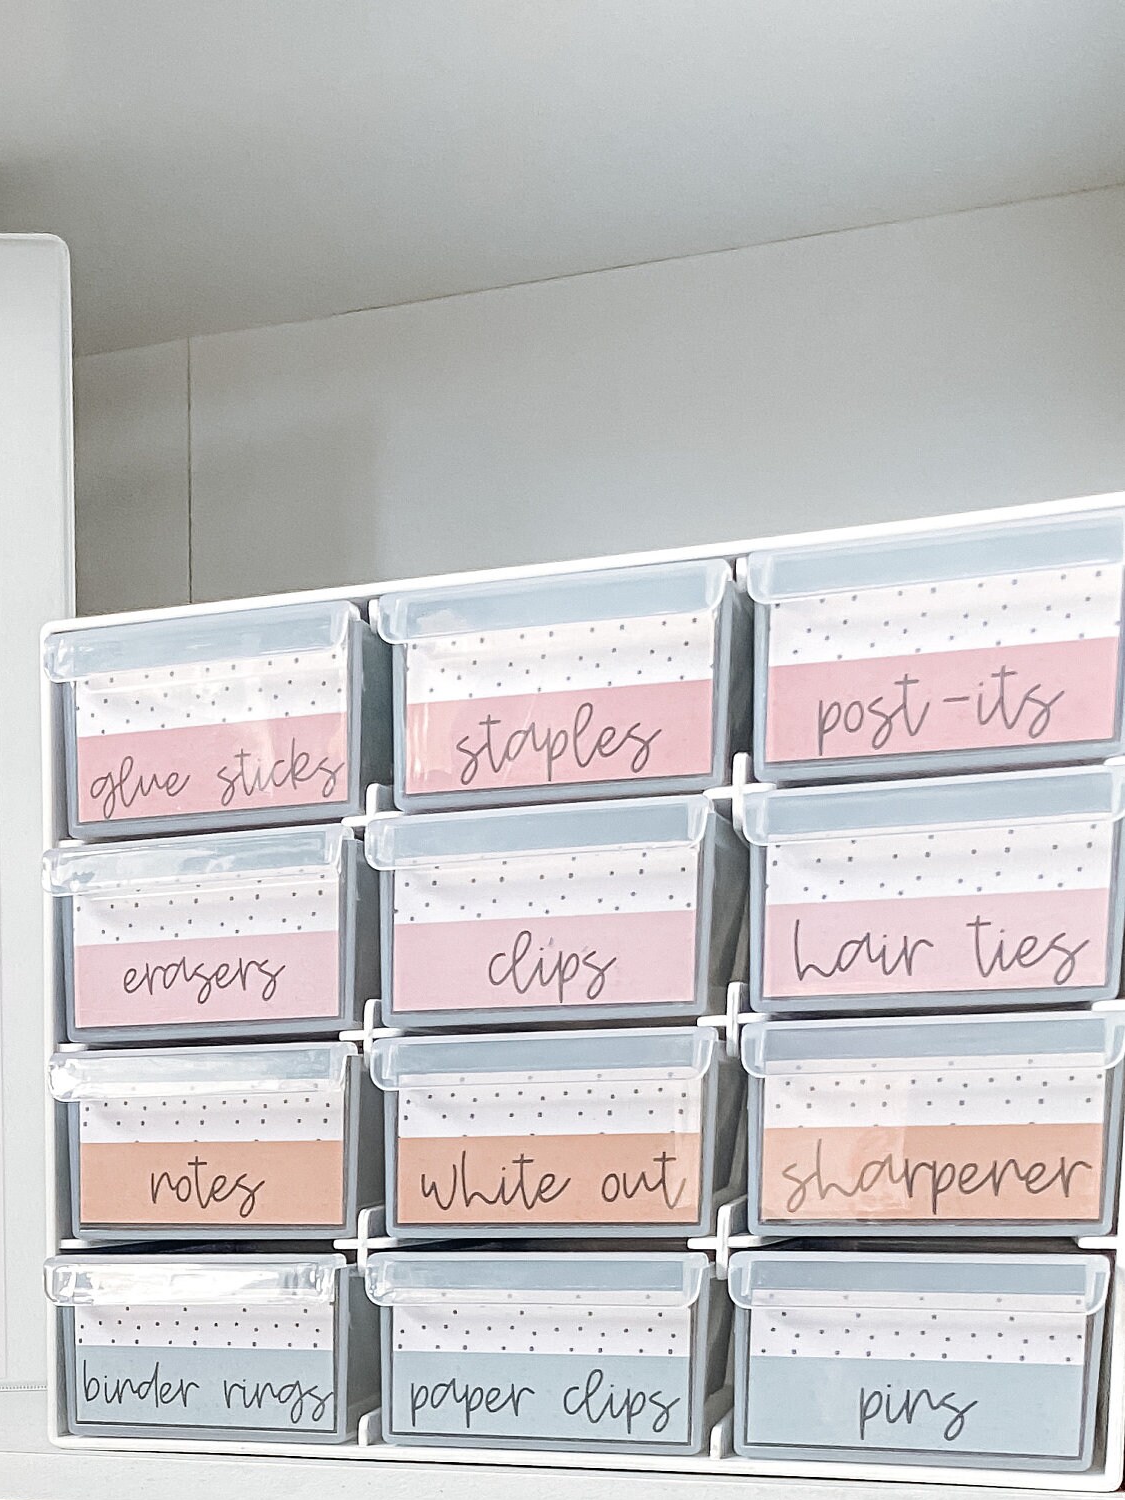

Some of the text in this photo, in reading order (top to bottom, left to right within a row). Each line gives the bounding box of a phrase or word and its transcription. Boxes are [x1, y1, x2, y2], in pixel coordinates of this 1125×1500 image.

[456, 702, 663, 785] staples
[817, 664, 1065, 756] post-its
[89, 737, 346, 819] glue sticks
[123, 956, 287, 1004] erasers
[488, 930, 618, 1004] clips
[794, 915, 1091, 986] hair ties
[150, 1155, 266, 1219] notes
[421, 1150, 687, 1211] white out
[782, 1138, 1093, 1216] sharpener
[83, 1359, 334, 1424] binder rings
[410, 1368, 681, 1434] paper clips
[859, 1383, 979, 1441] pins
